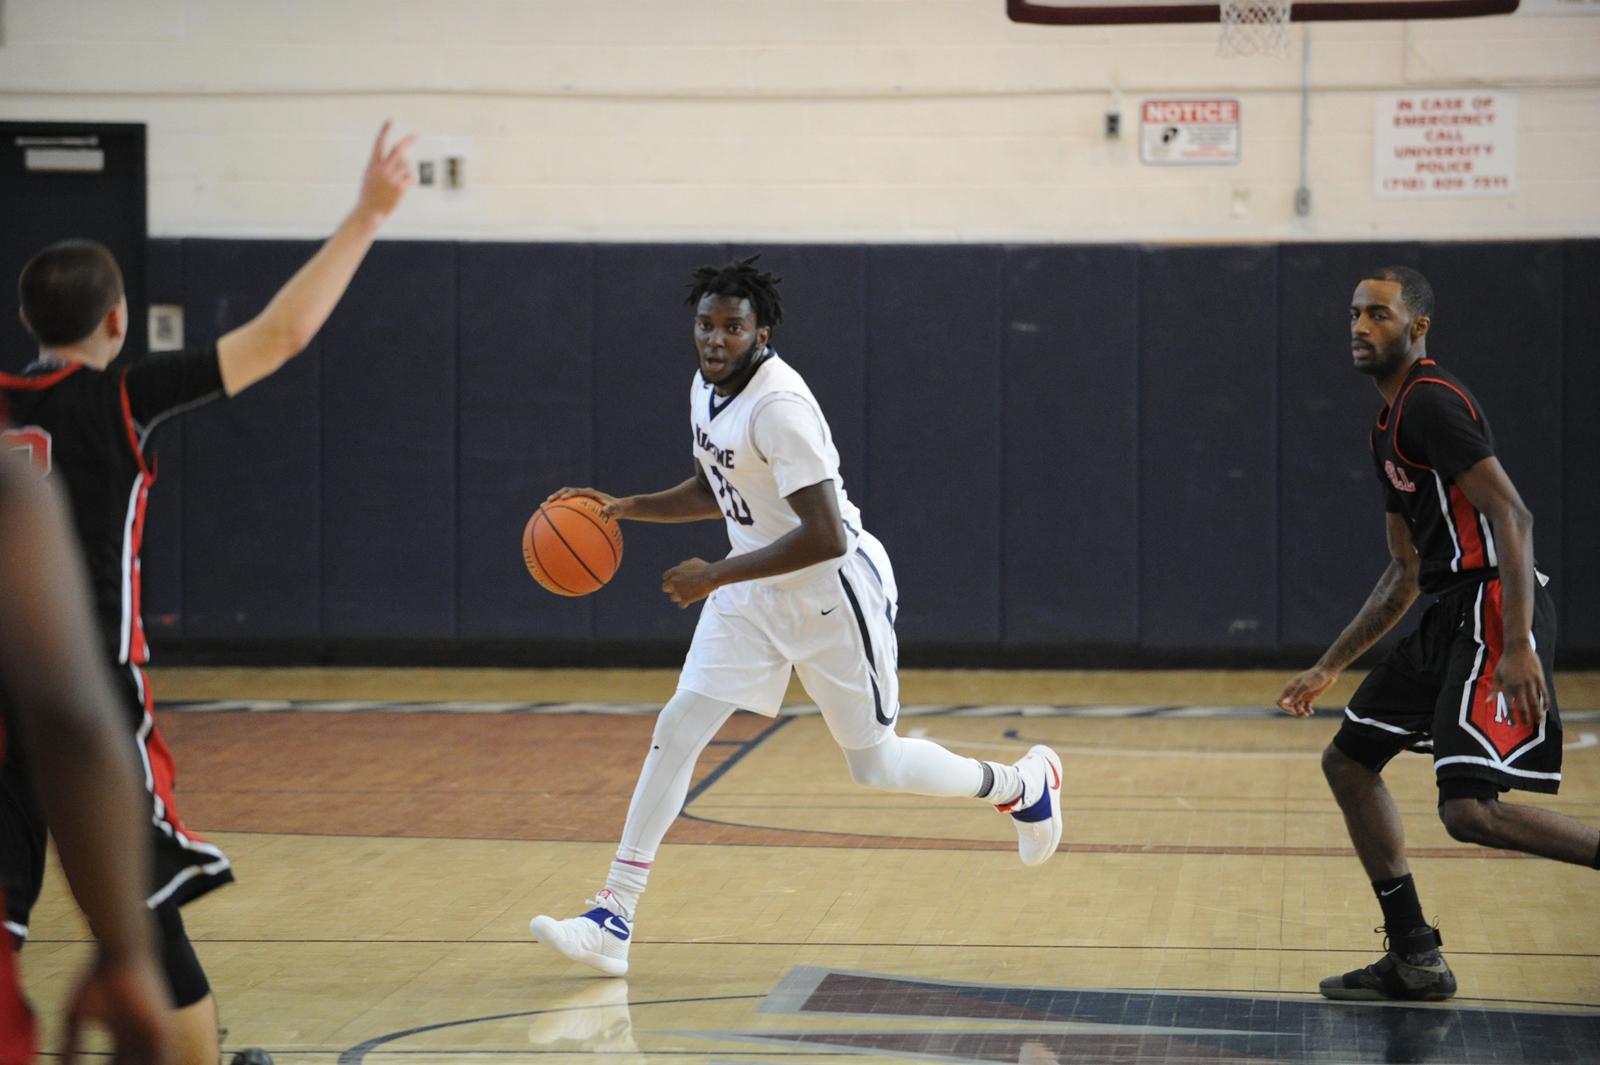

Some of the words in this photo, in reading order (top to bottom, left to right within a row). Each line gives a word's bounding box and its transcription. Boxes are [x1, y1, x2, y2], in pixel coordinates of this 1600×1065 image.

[1396, 99, 1413, 110] IN
[1421, 98, 1465, 110] CASE
[1472, 97, 1496, 109] OF
[1146, 102, 1234, 122] NOTICE
[1393, 113, 1496, 127] EMERGENCY
[1425, 130, 1464, 142] CALL
[1393, 145, 1495, 158] UNIVERSITY
[1415, 161, 1473, 173] POLICE
